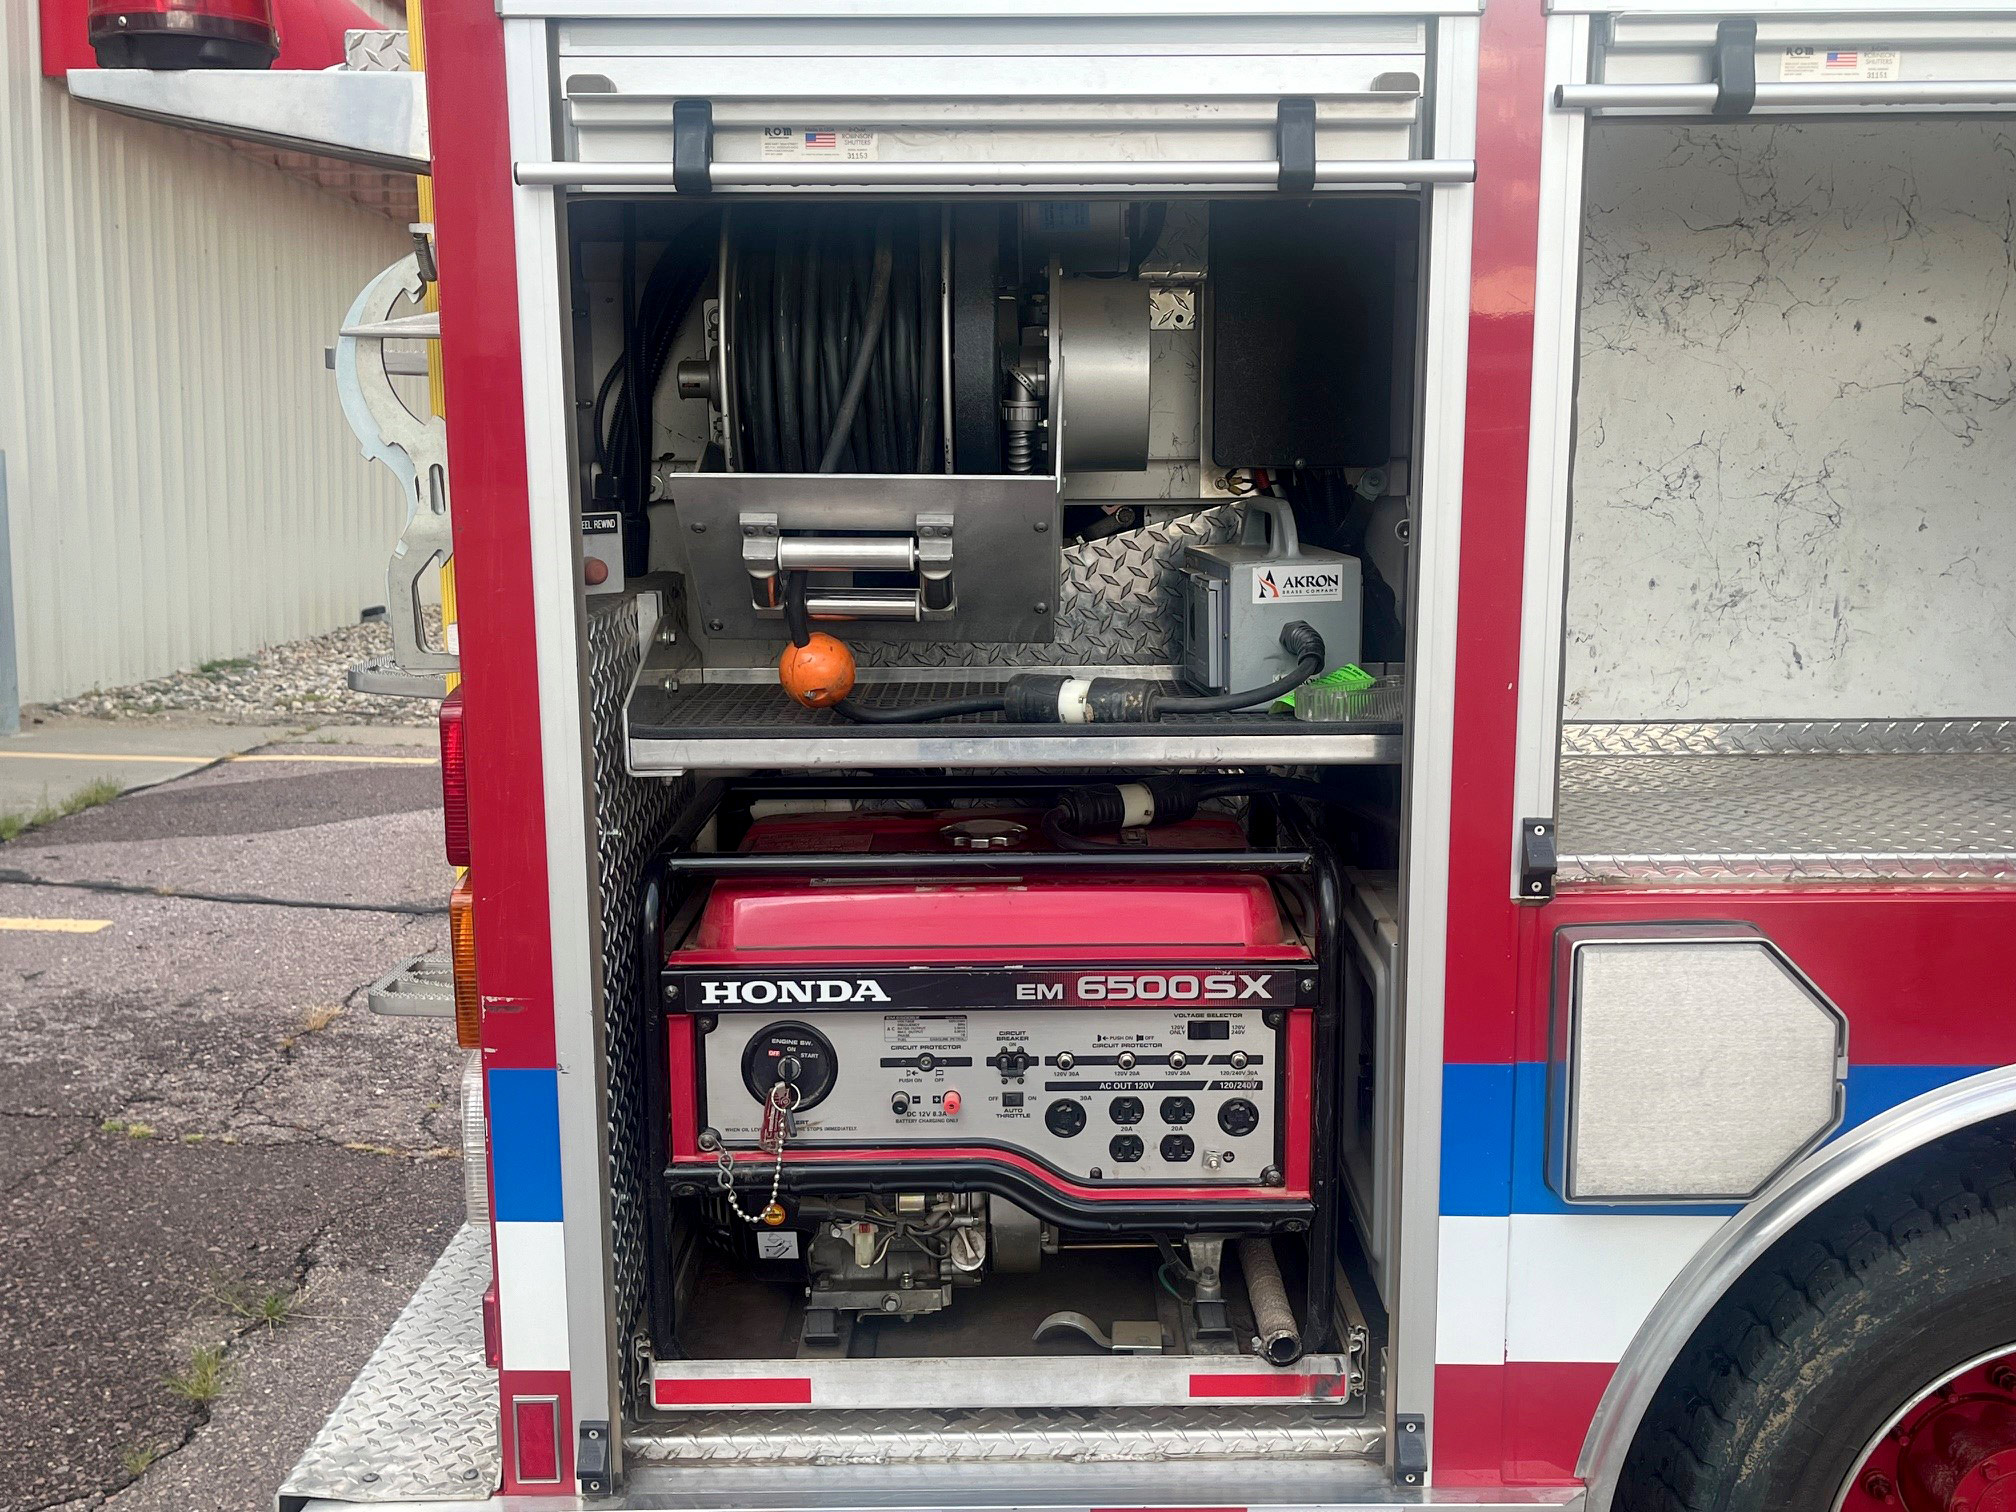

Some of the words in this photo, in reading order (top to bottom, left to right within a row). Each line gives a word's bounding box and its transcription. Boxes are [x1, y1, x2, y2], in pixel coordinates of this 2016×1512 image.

[582, 521, 592, 529] EEL
[594, 519, 615, 529] REWIND
[1283, 575, 1338, 588] AKRON
[701, 980, 892, 1004] HONDA
[1016, 984, 1062, 999] EM
[1077, 975, 1272, 999] 6500SX
